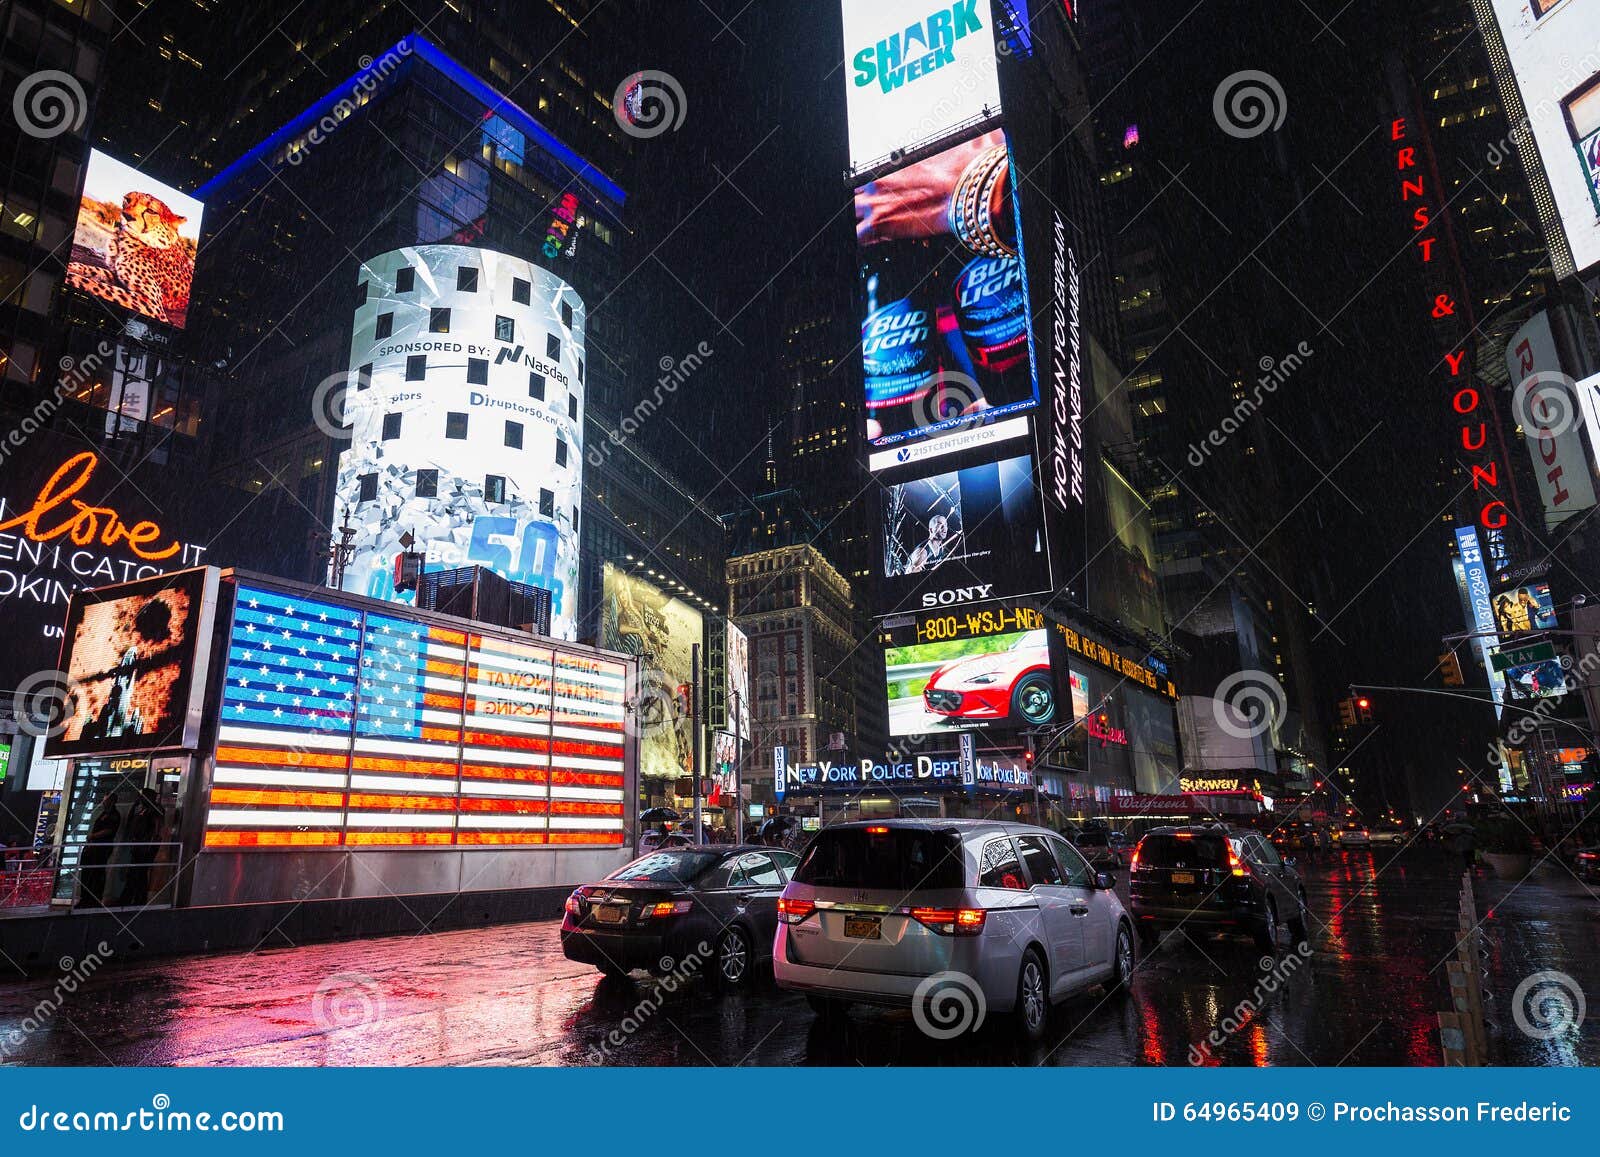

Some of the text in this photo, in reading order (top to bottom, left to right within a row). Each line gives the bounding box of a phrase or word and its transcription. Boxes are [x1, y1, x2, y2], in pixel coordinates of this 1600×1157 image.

[853, 0, 983, 88] SHARK
[881, 47, 956, 94] WEEK
[869, 310, 928, 338] BUD
[1054, 303, 1066, 360] YOU
[1391, 118, 1437, 263] ERNST
[1431, 294, 1455, 318] &
[1445, 350, 1509, 529] YOUNG
[379, 342, 569, 389] SPONSORED BY: Nasdaq
[1054, 359, 1067, 426] CAN
[1054, 422, 1067, 510] HOW
[0, 452, 181, 560] love
[182, 542, 207, 567] IT
[71, 551, 164, 583] CATC
[466, 515, 561, 576] 50
[0, 570, 94, 605] OKIN
[922, 584, 993, 607] SONY
[775, 747, 786, 792] NYPD
[861, 759, 913, 780] POLICE
[961, 735, 973, 787] NYPD
[1117, 797, 1189, 815] Walgreens
[1179, 777, 1239, 793] Subway
